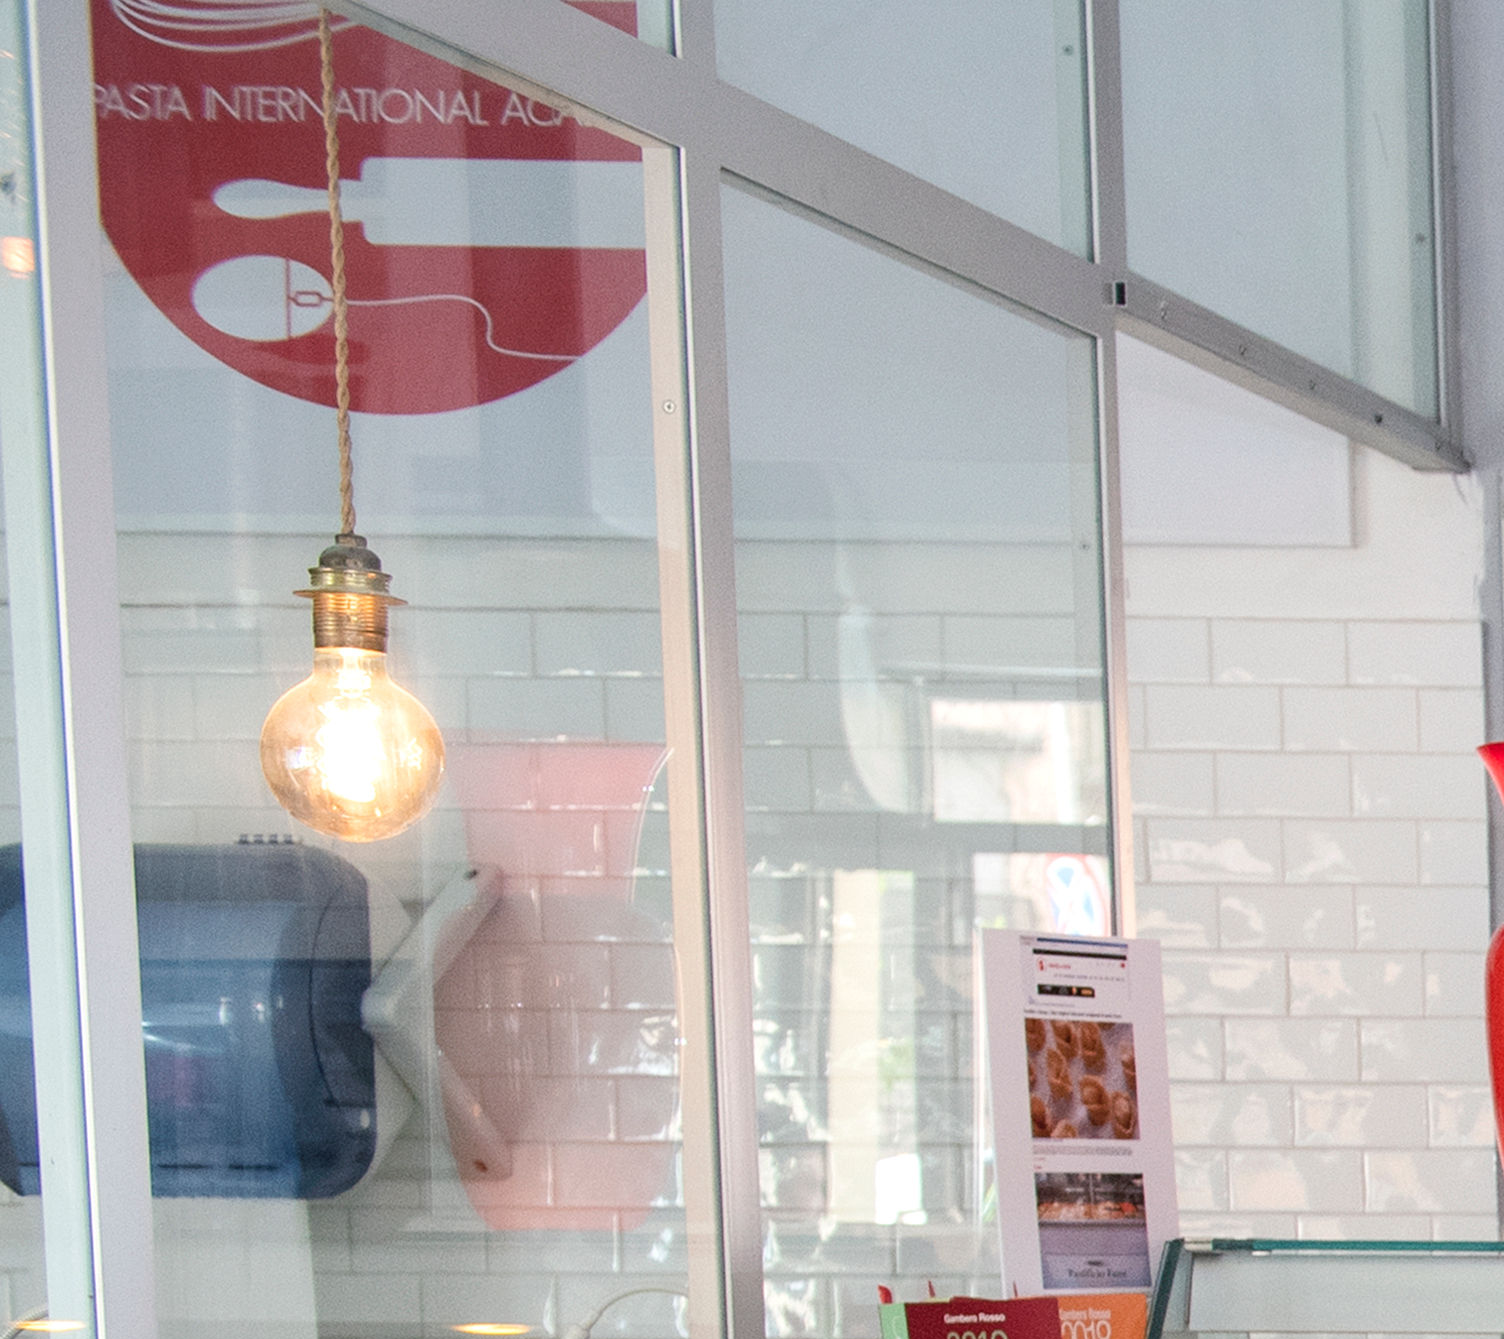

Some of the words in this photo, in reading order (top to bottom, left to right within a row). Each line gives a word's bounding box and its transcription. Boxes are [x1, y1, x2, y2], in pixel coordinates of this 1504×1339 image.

[202, 84, 489, 126] INTERNATIONAL
[944, 1313, 978, 1324] Gambero
[978, 1312, 1006, 1323] Rosso
